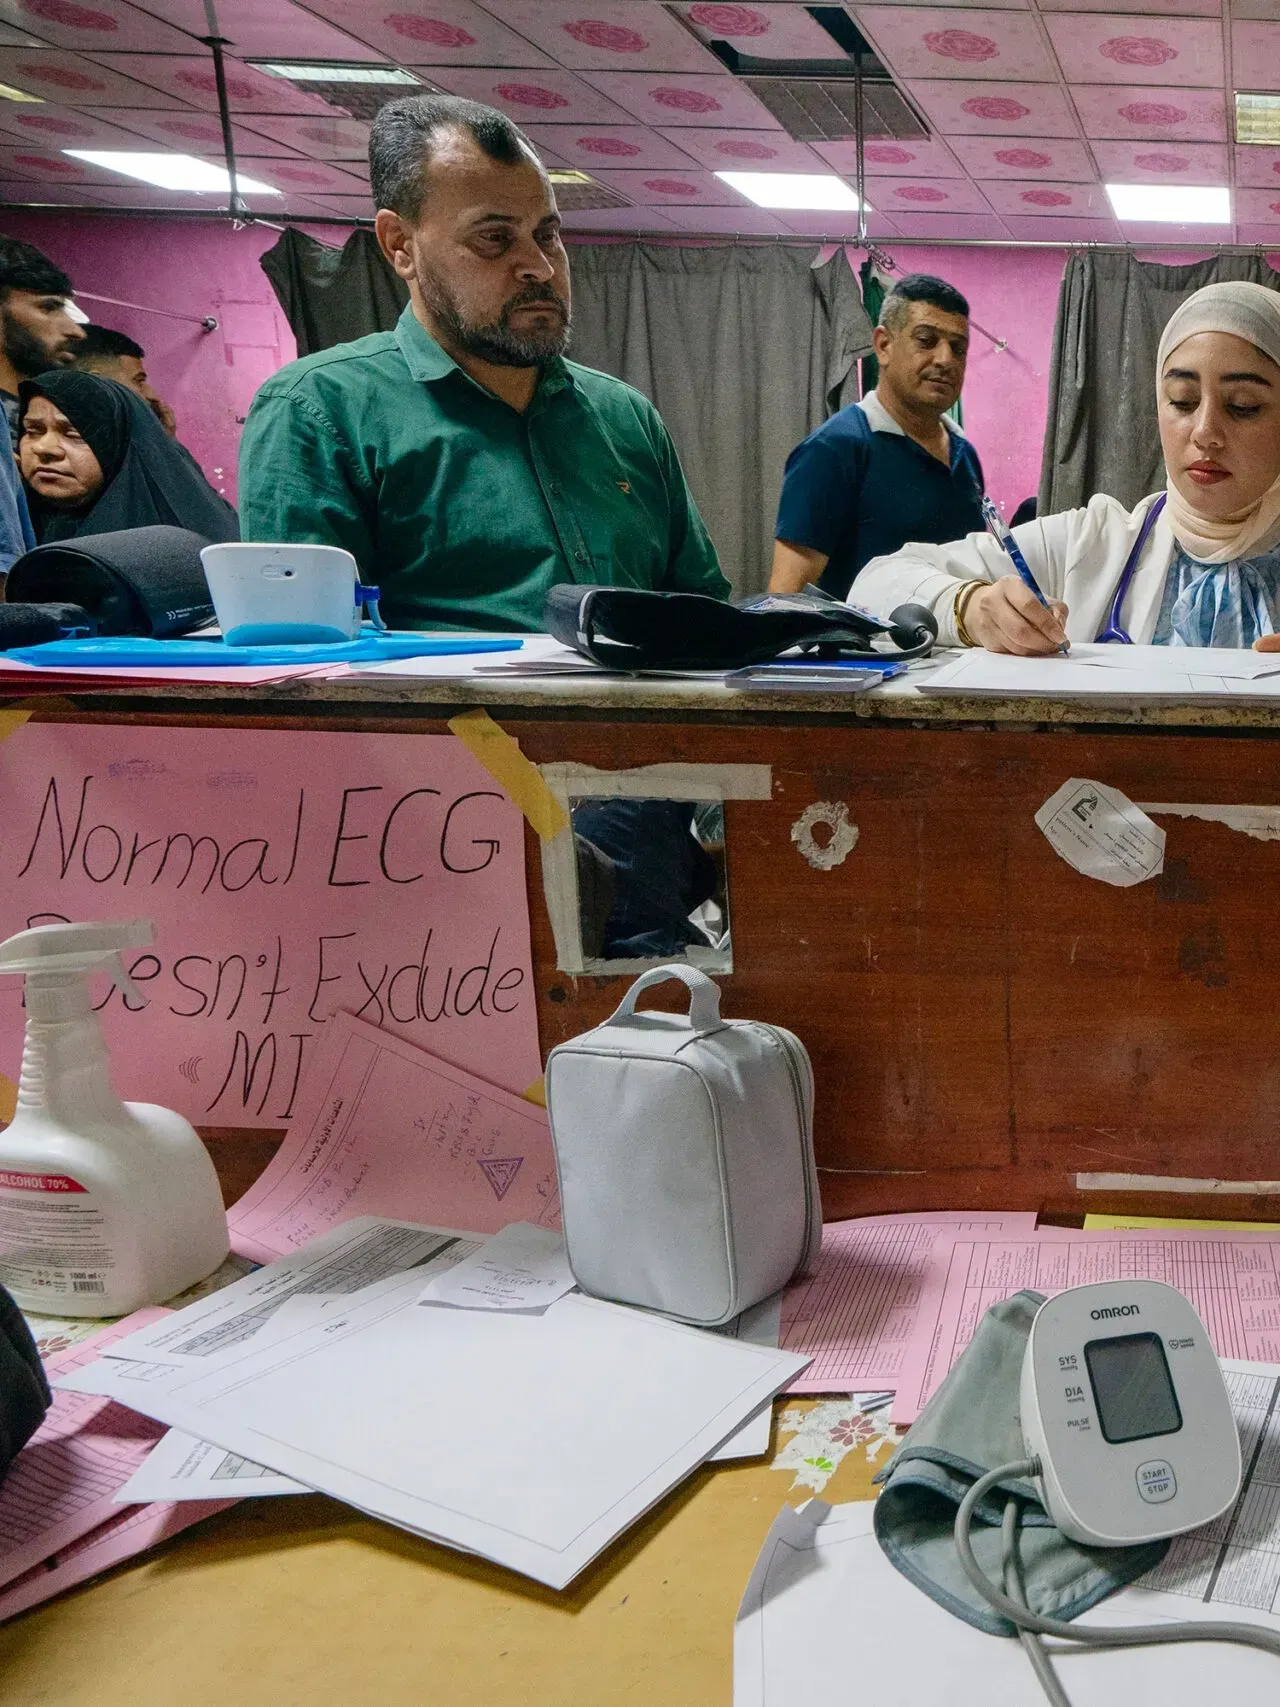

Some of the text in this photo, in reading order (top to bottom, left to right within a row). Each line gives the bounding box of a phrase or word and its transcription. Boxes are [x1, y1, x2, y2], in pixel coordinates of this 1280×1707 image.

[17, 775, 505, 895] Normal ECG
[307, 926, 525, 1028] Exclude
[205, 1029, 313, 1120] MI
[0, 1174, 70, 1190] ALCOHOL 70%
[1090, 1304, 1140, 1320] OMRON
[1058, 1355, 1078, 1366] SYS
[1064, 1386, 1084, 1398] DIA
[1067, 1417, 1090, 1428] PULSE
[1142, 1468, 1167, 1480] START
[1147, 1483, 1169, 1494] STOP
